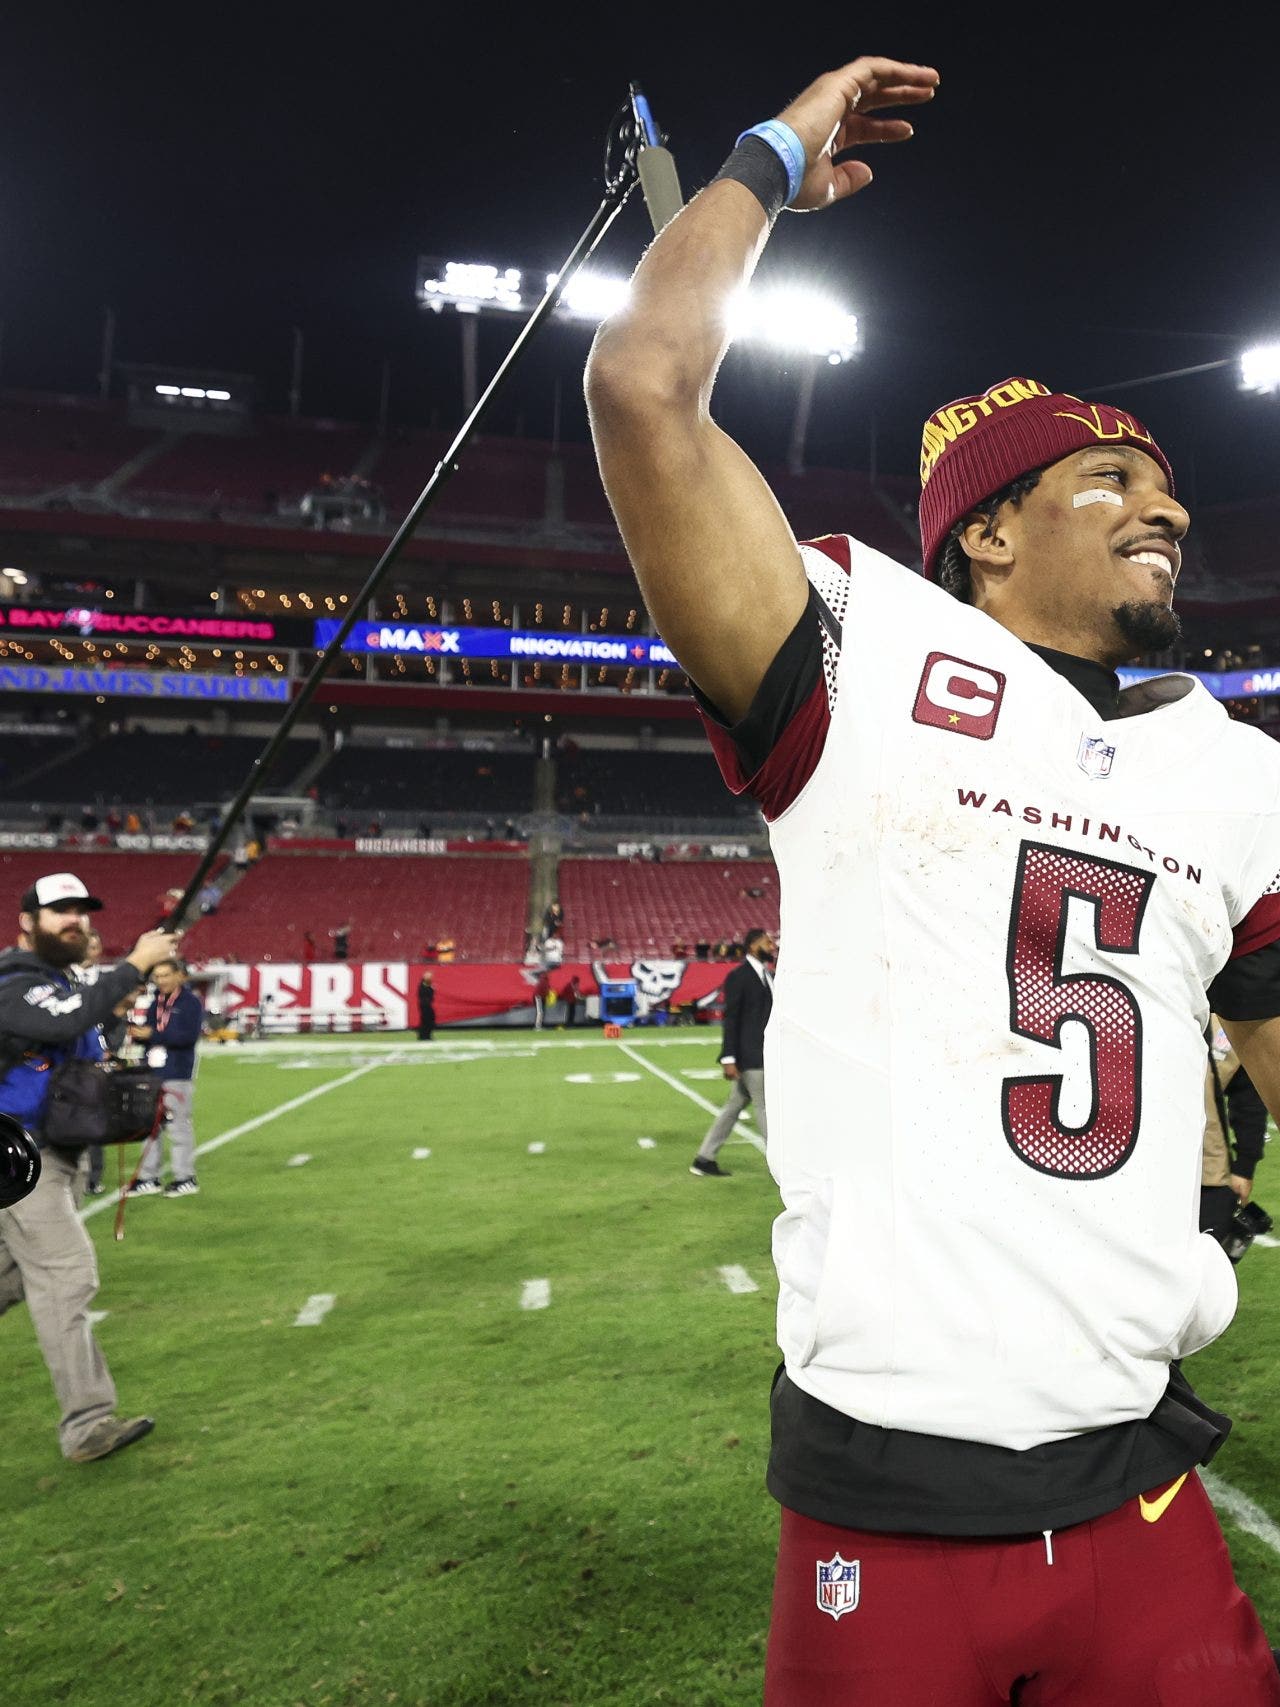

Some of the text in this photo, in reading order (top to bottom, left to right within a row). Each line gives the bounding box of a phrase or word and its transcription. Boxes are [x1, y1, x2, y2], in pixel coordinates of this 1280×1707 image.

[510, 637, 627, 660] INNOVATION
[52, 669, 153, 693] JAMES
[162, 675, 289, 702] STADIUM
[957, 789, 1201, 884] WASHINGTON
[1001, 839, 1157, 1181] 5
[823, 1584, 852, 1607] NFL
